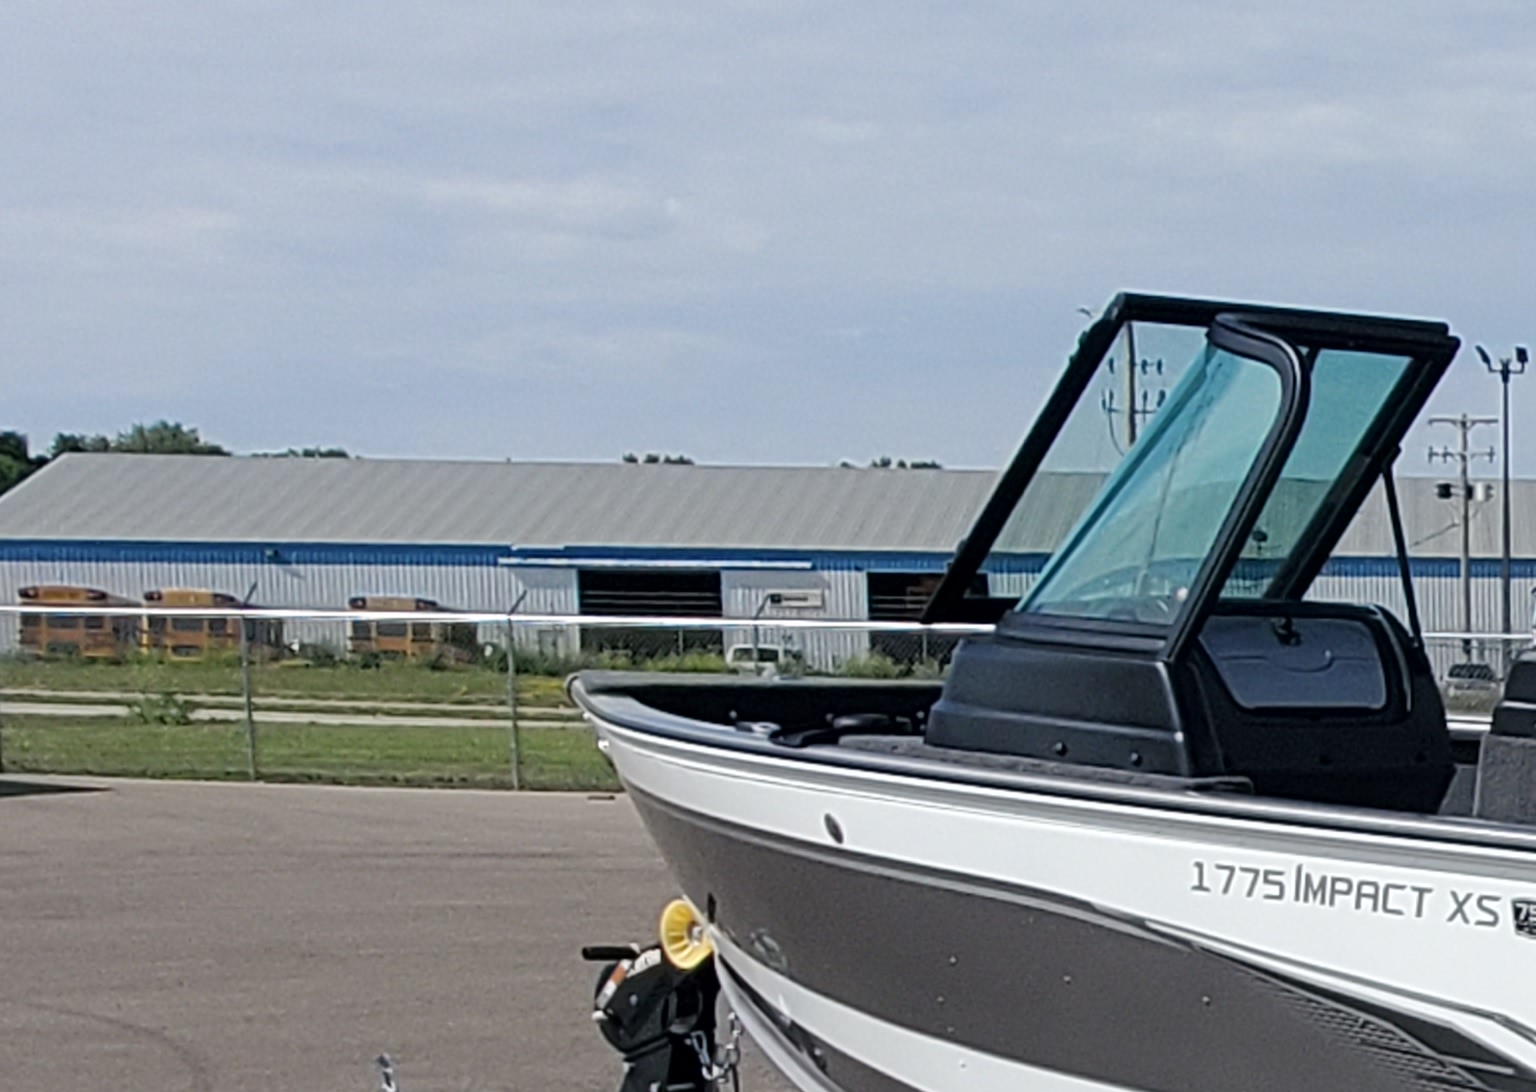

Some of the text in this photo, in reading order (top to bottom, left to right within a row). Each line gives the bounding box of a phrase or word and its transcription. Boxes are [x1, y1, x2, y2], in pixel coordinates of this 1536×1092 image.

[1190, 860, 1502, 928] 1775 IMPACT XS
